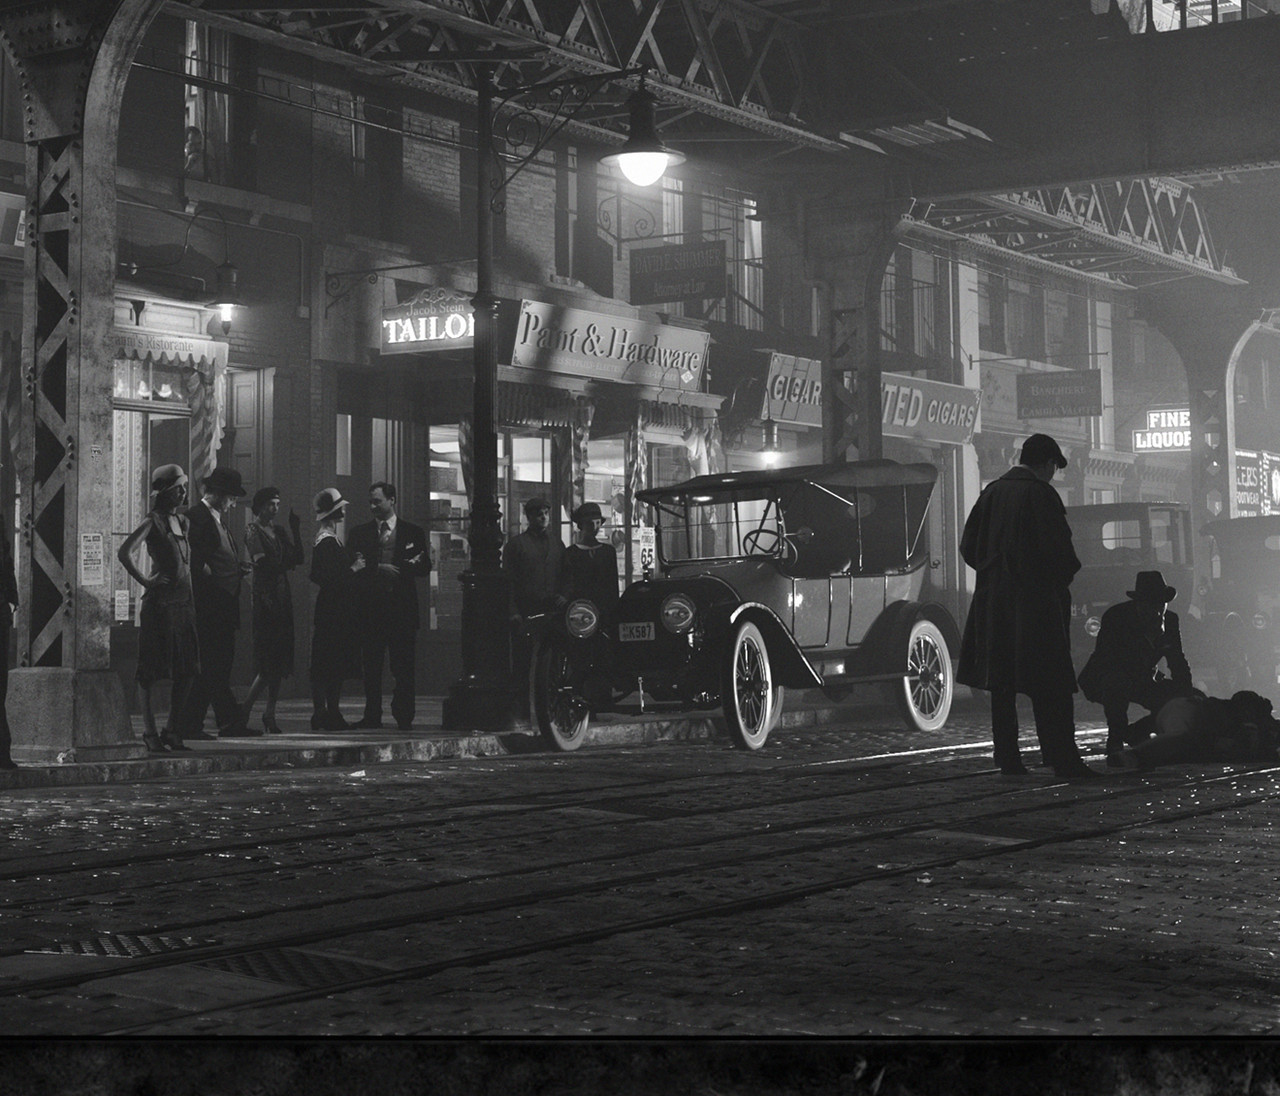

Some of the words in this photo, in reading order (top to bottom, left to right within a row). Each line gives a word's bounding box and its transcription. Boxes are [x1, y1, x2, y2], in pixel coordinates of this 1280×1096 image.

[406, 303, 436, 316] Jacob
[439, 301, 465, 313] Stein
[146, 335, 195, 352] Ristorante
[581, 323, 604, 357] &
[606, 327, 701, 371] Hardware
[771, 374, 822, 406] CIGAR
[882, 384, 924, 428] TED
[927, 399, 976, 429] CIGARS
[1149, 411, 1191, 429] FINE
[641, 548, 653, 566] 65
